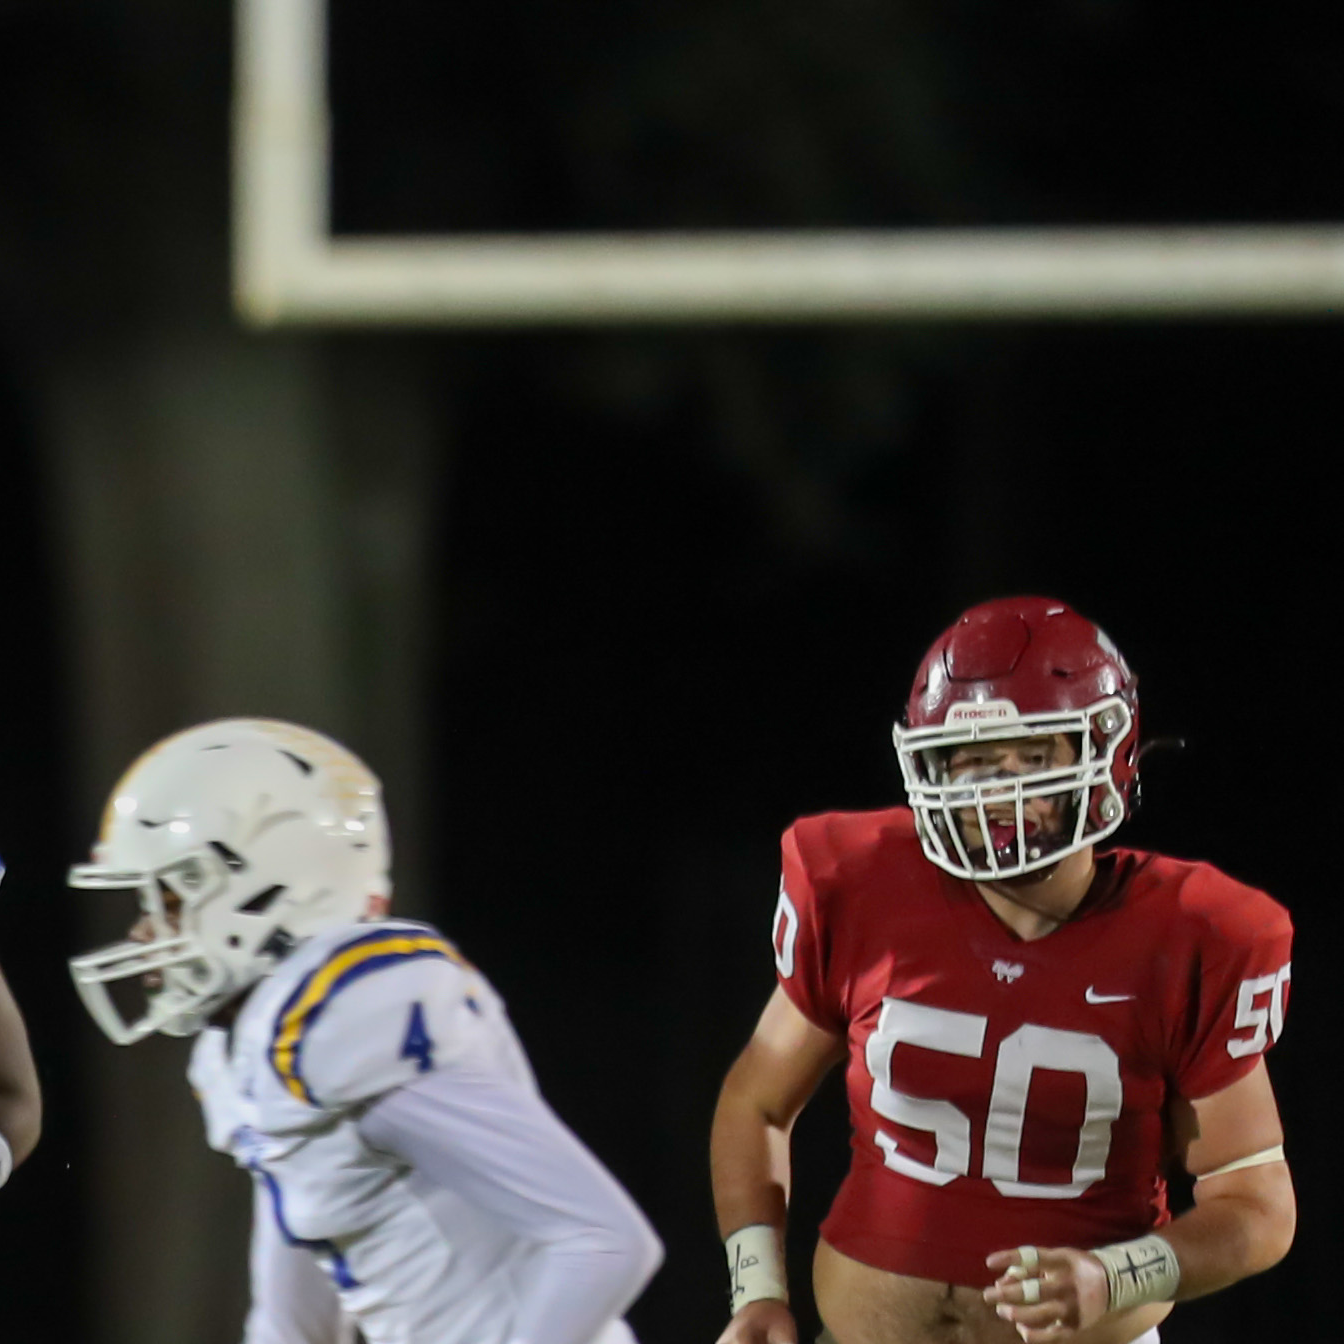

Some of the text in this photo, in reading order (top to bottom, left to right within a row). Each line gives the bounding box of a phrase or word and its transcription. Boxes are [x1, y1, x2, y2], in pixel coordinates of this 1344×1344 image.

[772, 873, 798, 979] 0
[398, 1001, 436, 1075] 4
[865, 996, 1123, 1199] 50
